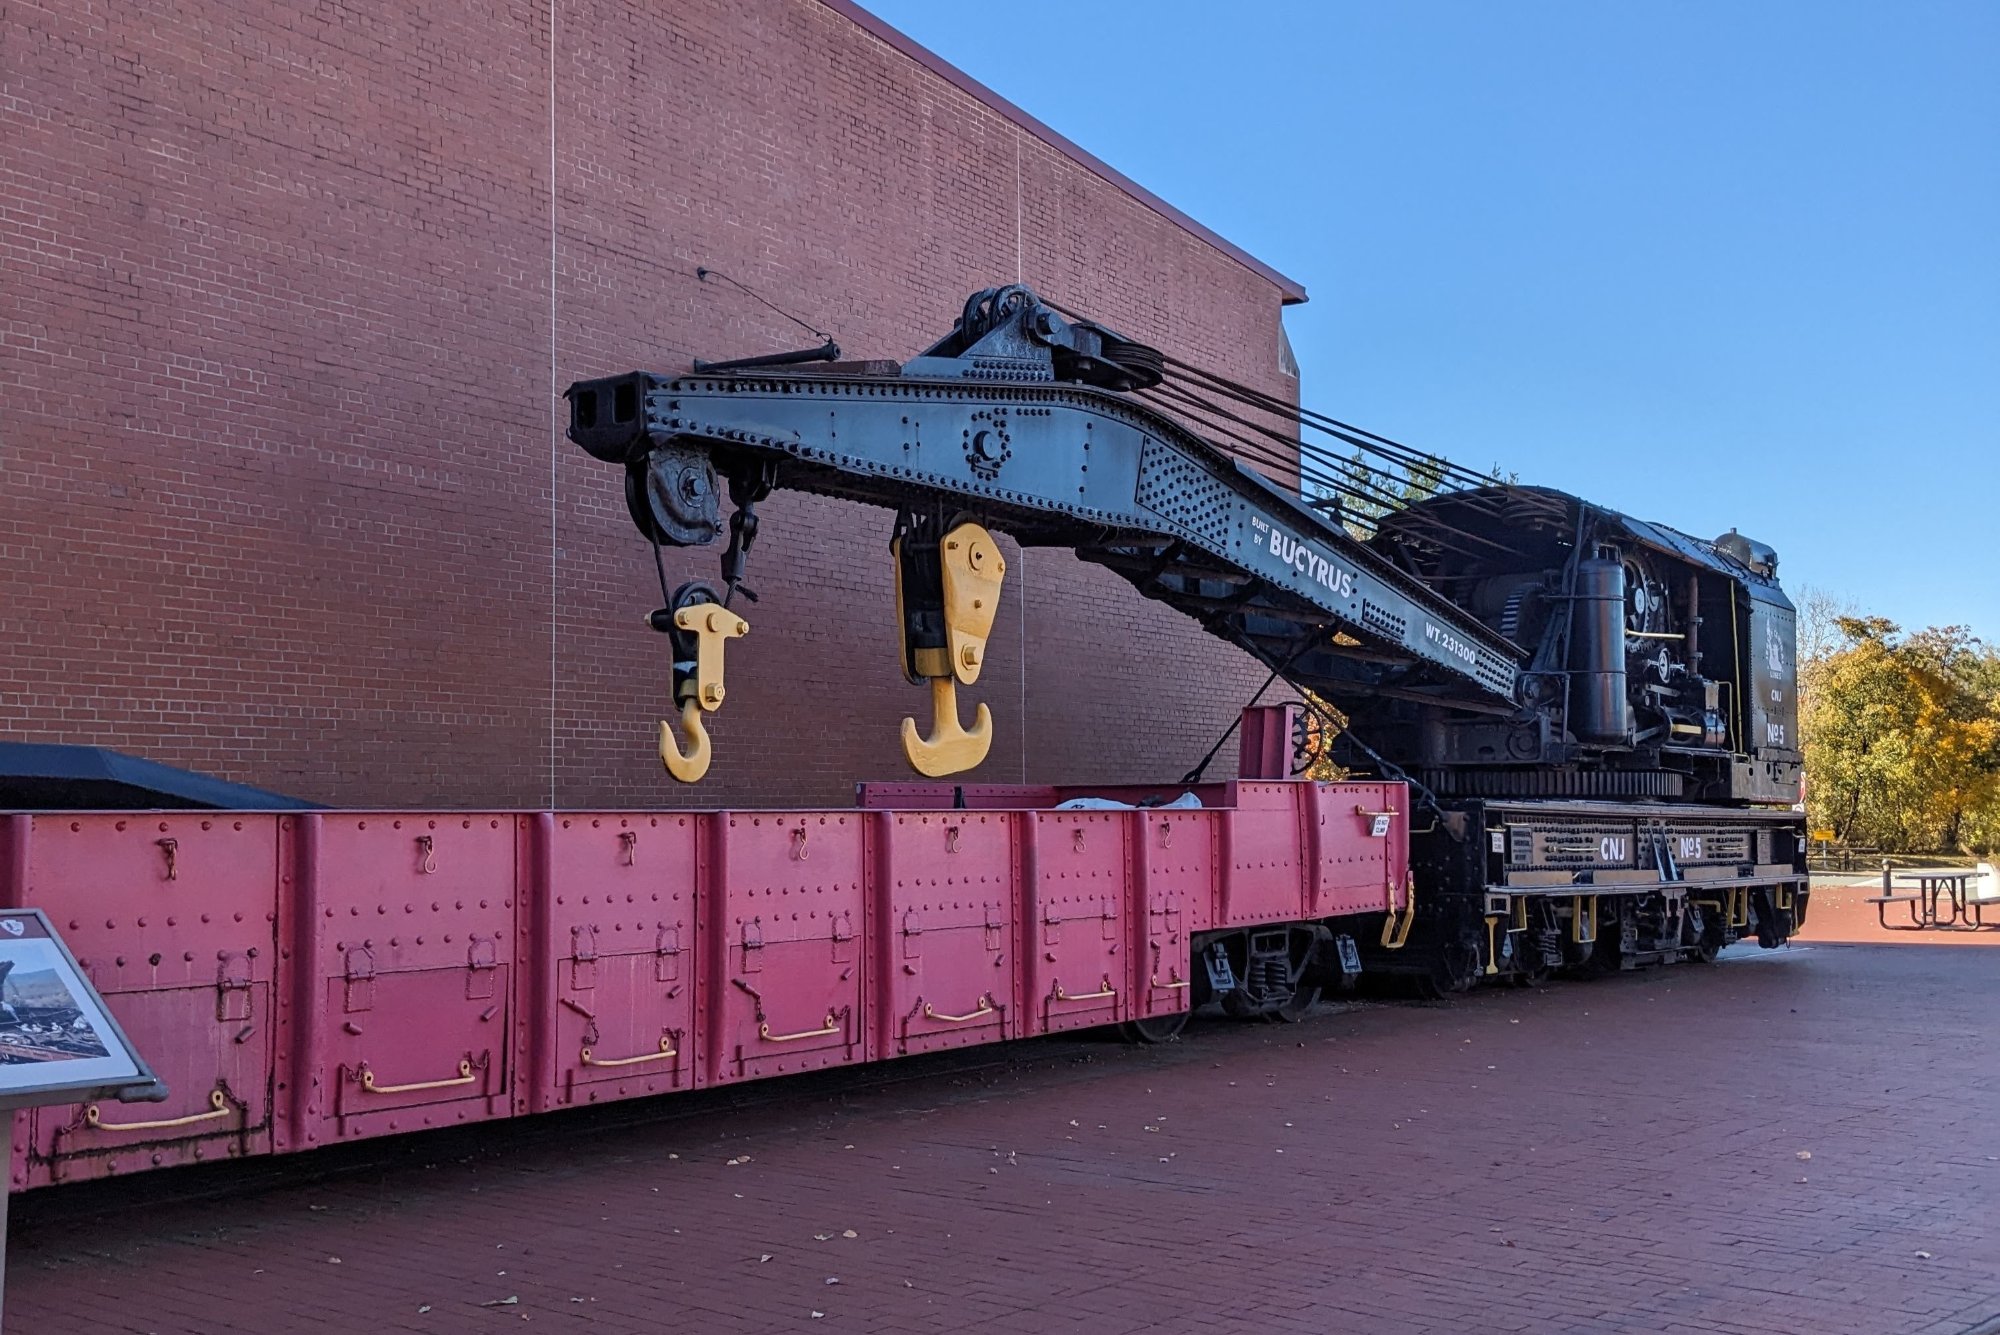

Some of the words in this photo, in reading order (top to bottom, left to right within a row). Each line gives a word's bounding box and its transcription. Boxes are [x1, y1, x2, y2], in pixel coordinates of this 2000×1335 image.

[1251, 515, 1270, 534] BUILT
[1253, 533, 1263, 546] BY
[1269, 528, 1352, 598] BUCYRUS
[1770, 689, 1782, 703] CNJ
[1600, 837, 1625, 861] CNJ
